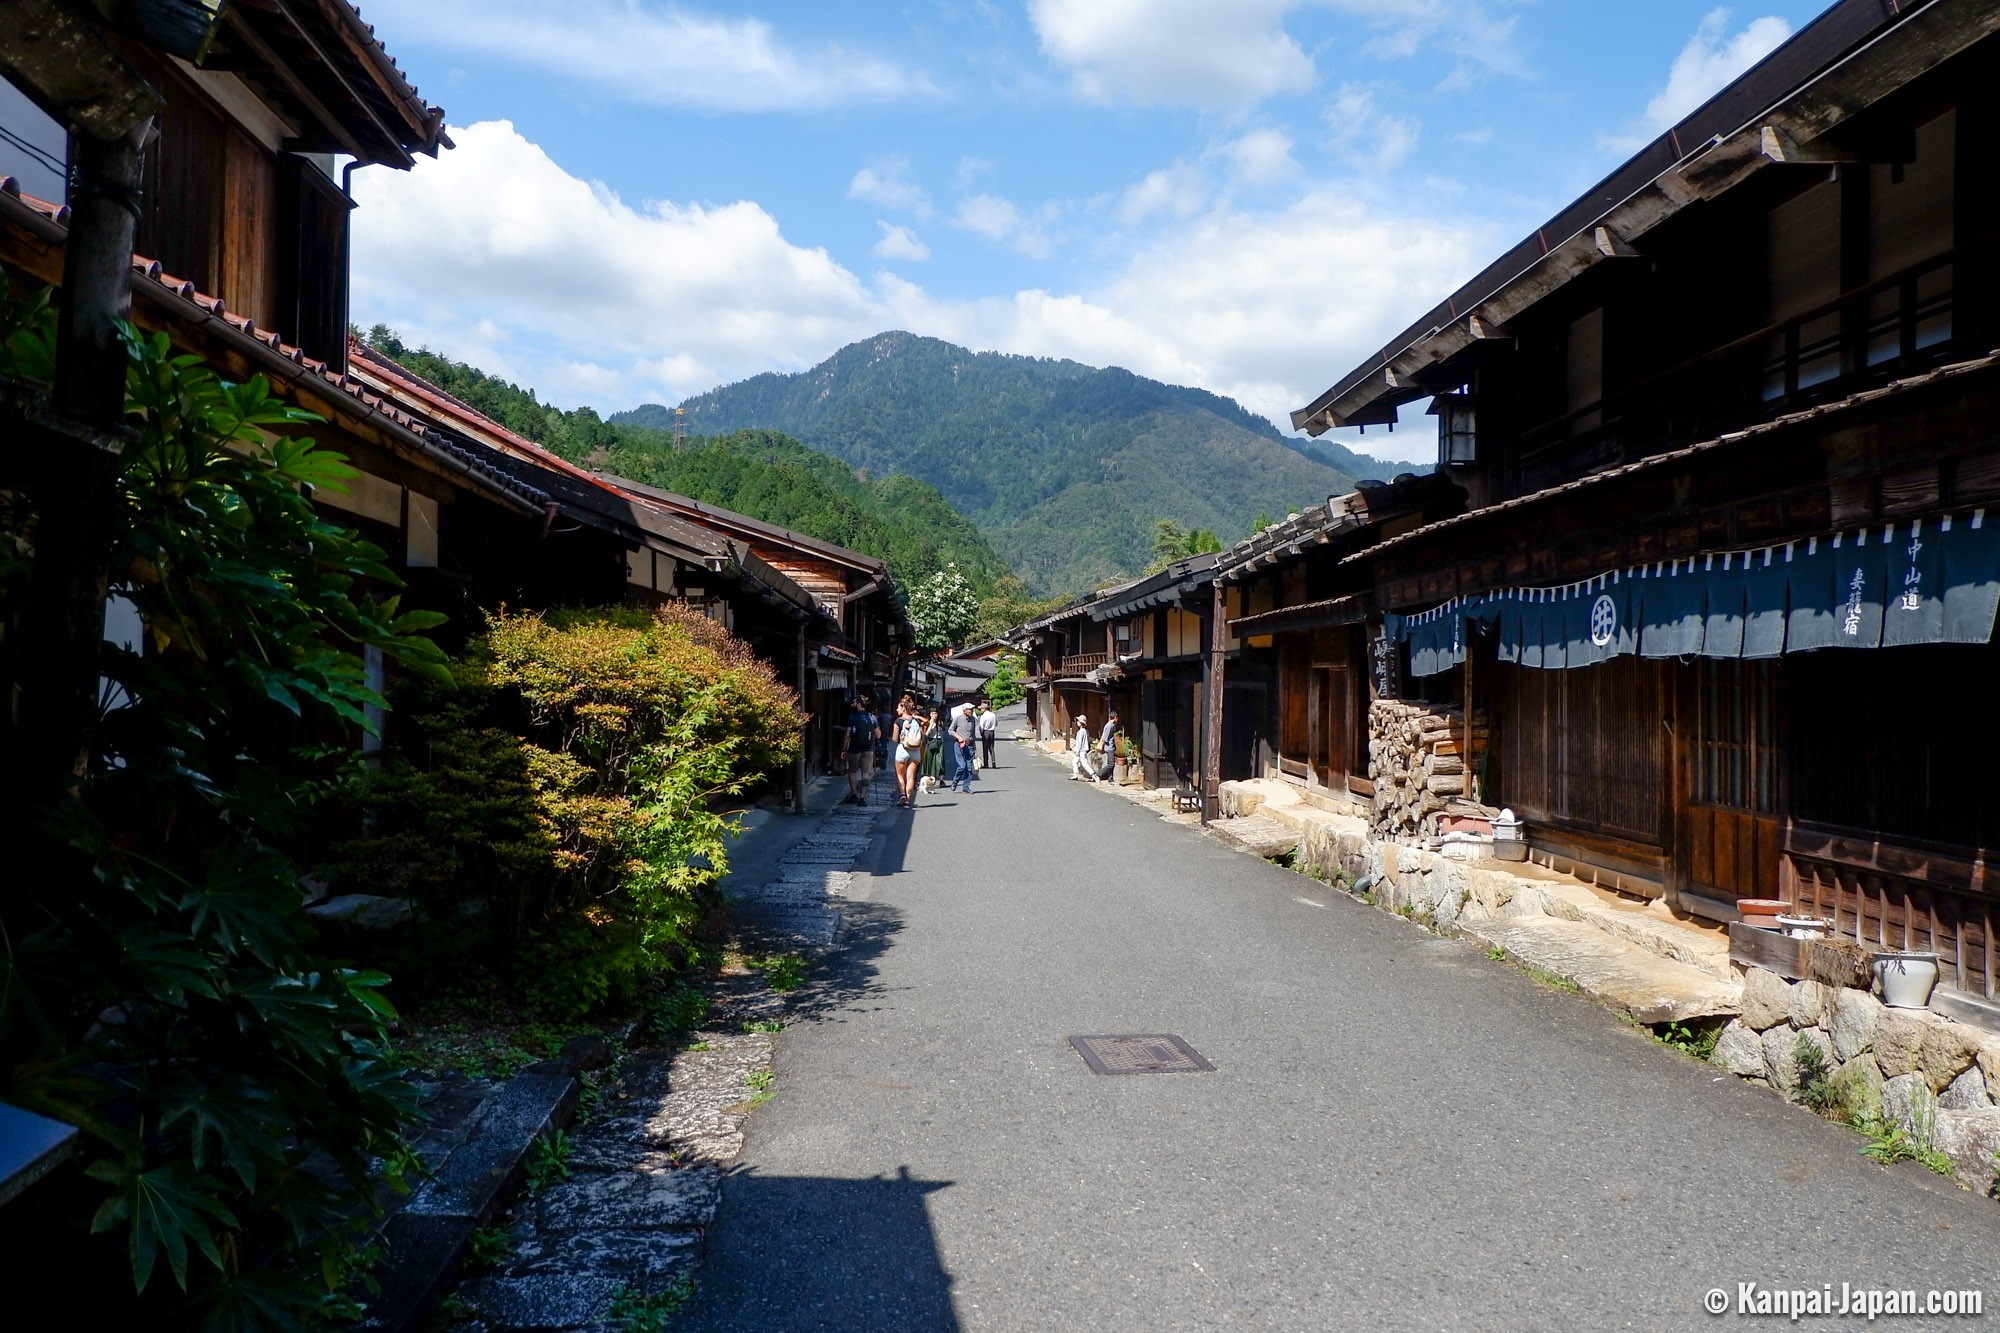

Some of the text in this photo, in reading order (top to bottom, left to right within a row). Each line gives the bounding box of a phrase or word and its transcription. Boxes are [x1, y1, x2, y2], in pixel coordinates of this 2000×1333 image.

[1843, 567, 1866, 636] 妻籠宿
[1901, 539, 1923, 611] 中山道
